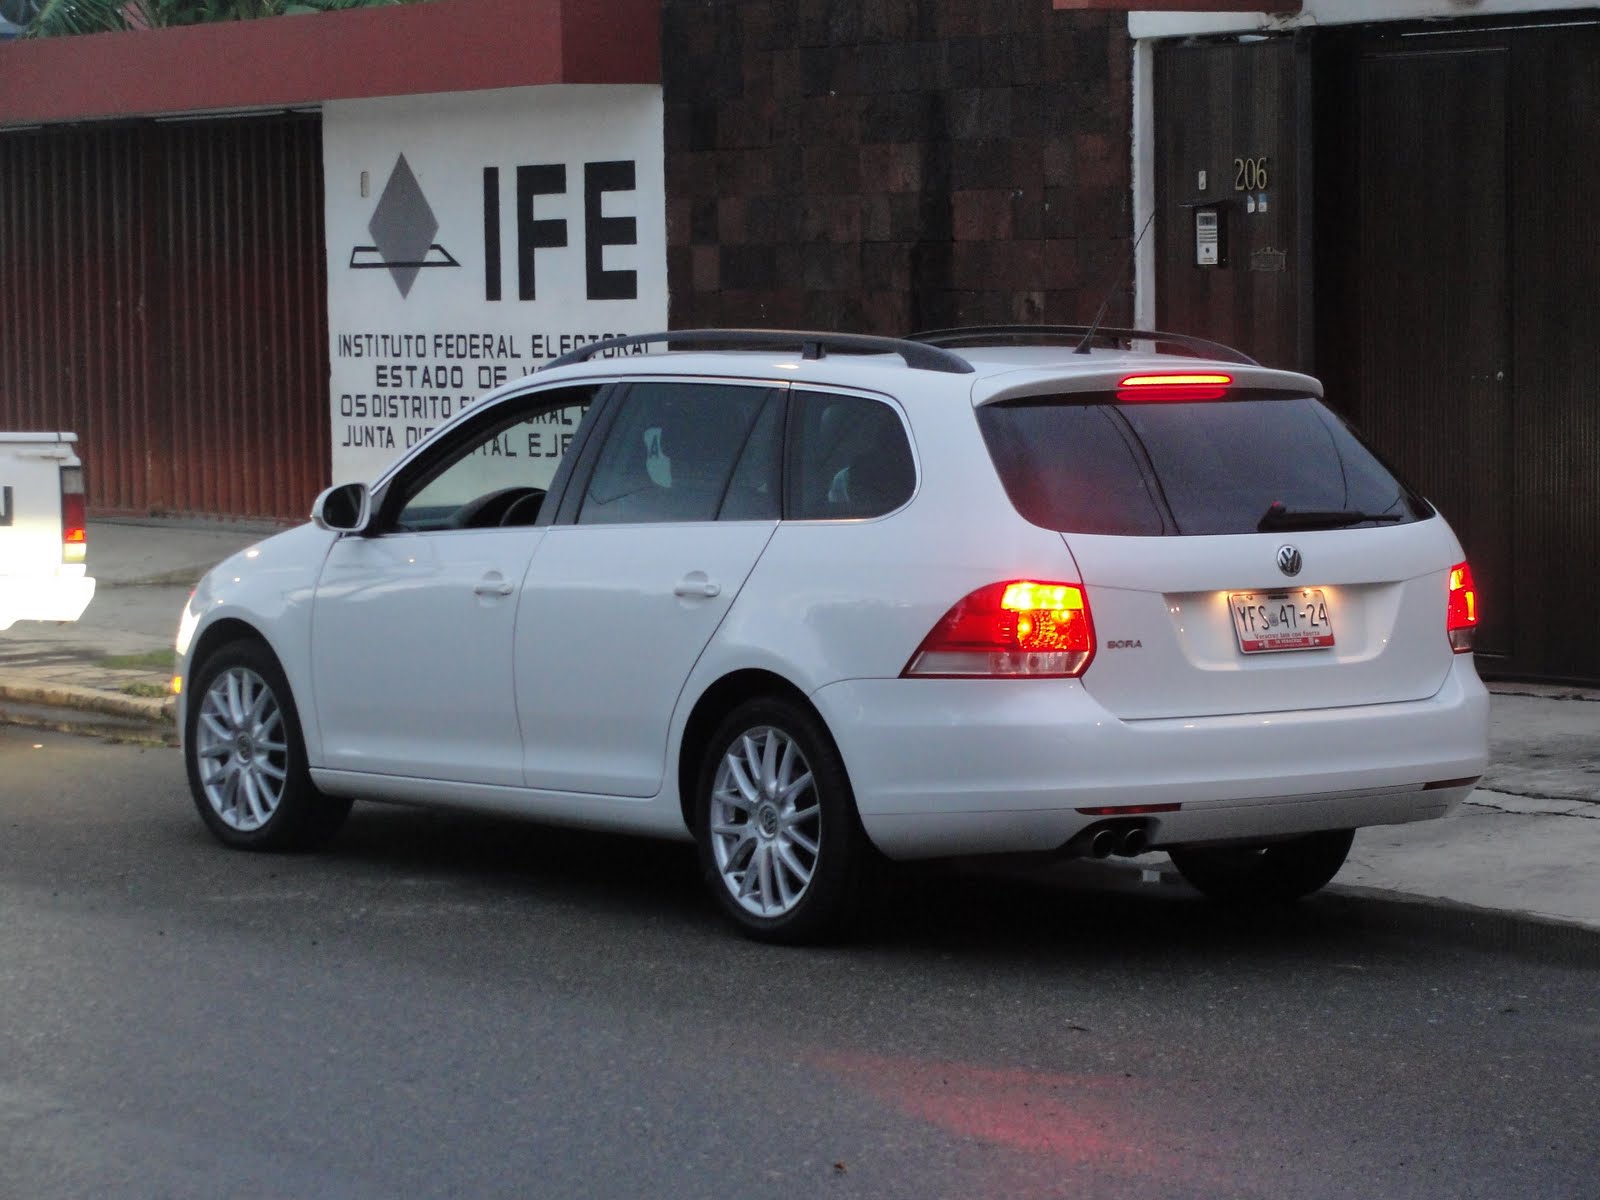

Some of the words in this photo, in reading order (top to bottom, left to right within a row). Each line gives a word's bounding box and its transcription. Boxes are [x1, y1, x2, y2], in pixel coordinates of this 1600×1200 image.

[1234, 157, 1268, 191] 206
[483, 160, 638, 302] IFE
[338, 333, 427, 358] INSTITUTO
[433, 333, 522, 359] FEDERAL
[376, 365, 464, 389] ESTADO
[478, 366, 507, 389] DE
[372, 394, 452, 419] DISTRITO
[342, 425, 395, 448] JUNTA
[1237, 605, 1270, 632] YFS
[1279, 603, 1328, 628] 47-24
